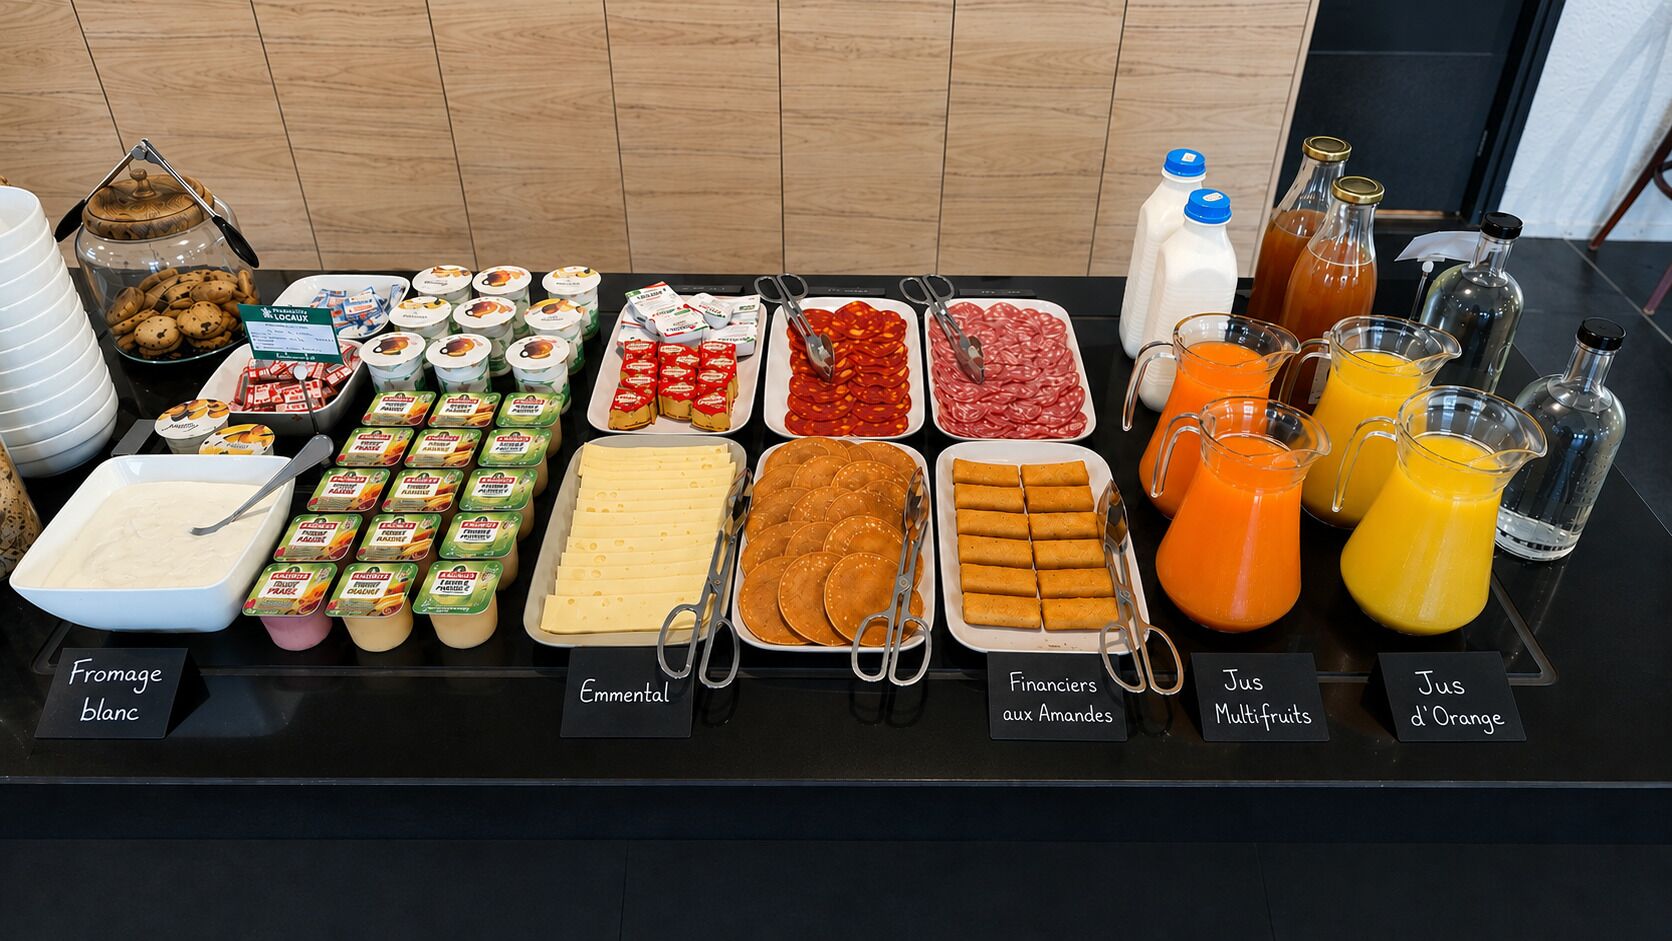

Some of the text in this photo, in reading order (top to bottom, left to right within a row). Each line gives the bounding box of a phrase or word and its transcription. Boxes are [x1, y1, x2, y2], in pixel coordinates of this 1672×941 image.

[275, 314, 309, 322] LOCAUX
[69, 658, 162, 694] Fromage
[1010, 672, 1097, 692] Financiers
[1223, 669, 1263, 690] Jus
[1415, 671, 1464, 695] Jus
[580, 679, 669, 702] Emmental
[80, 697, 139, 721] blanc
[1004, 704, 1112, 722] aux Amandes
[1216, 703, 1311, 731] Multifruits
[1411, 706, 1504, 734] d'Orange
